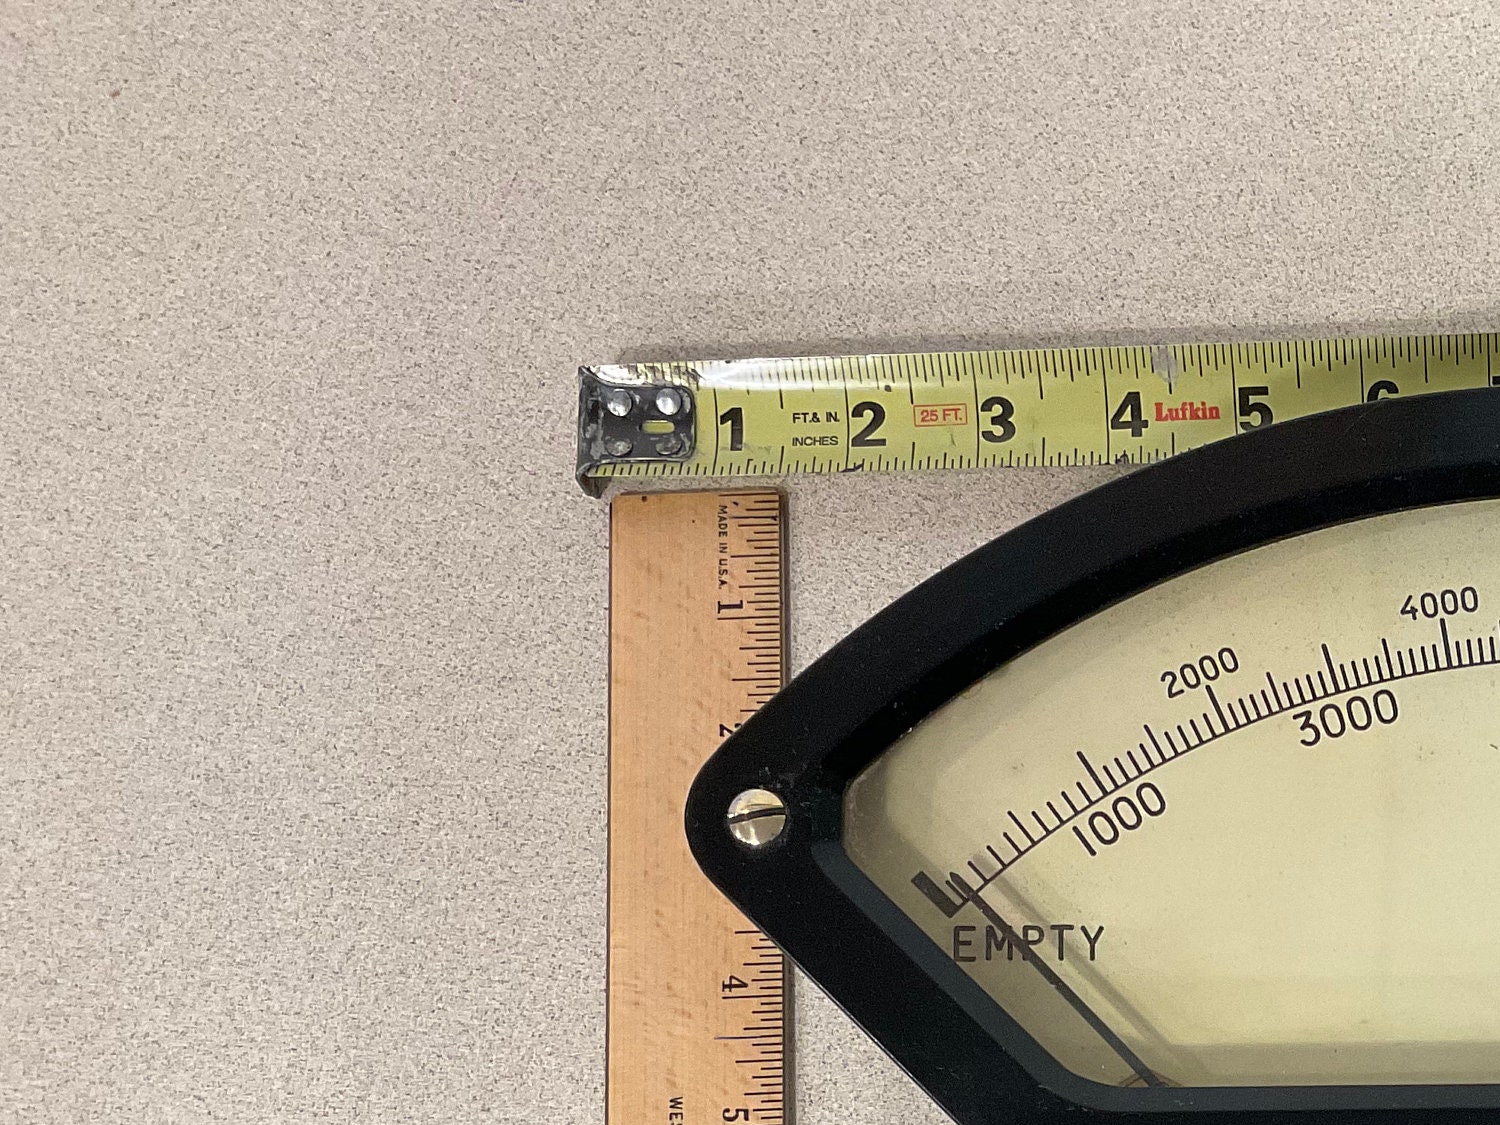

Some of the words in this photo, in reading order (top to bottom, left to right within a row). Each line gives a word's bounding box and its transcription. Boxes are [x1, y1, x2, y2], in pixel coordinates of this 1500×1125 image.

[851, 401, 887, 448] 2
[920, 409, 939, 423] 25
[942, 408, 963, 422] FT.
[981, 396, 1016, 444] 3
[1111, 392, 1148, 437] 4
[1154, 402, 1221, 423] Lufkin
[1238, 386, 1274, 431] 5
[719, 407, 744, 452] 1
[792, 435, 839, 447] INCHES
[718, 504, 728, 538] MADE
[719, 542, 728, 556] IN
[717, 600, 743, 614] 1
[1400, 585, 1480, 621] 4000
[1160, 647, 1239, 699] 2000
[1292, 689, 1400, 747] 3000
[1072, 782, 1167, 856] 1000
[953, 924, 1105, 962] EMPTY
[722, 974, 748, 993] 4
[722, 1107, 750, 1123] 5
